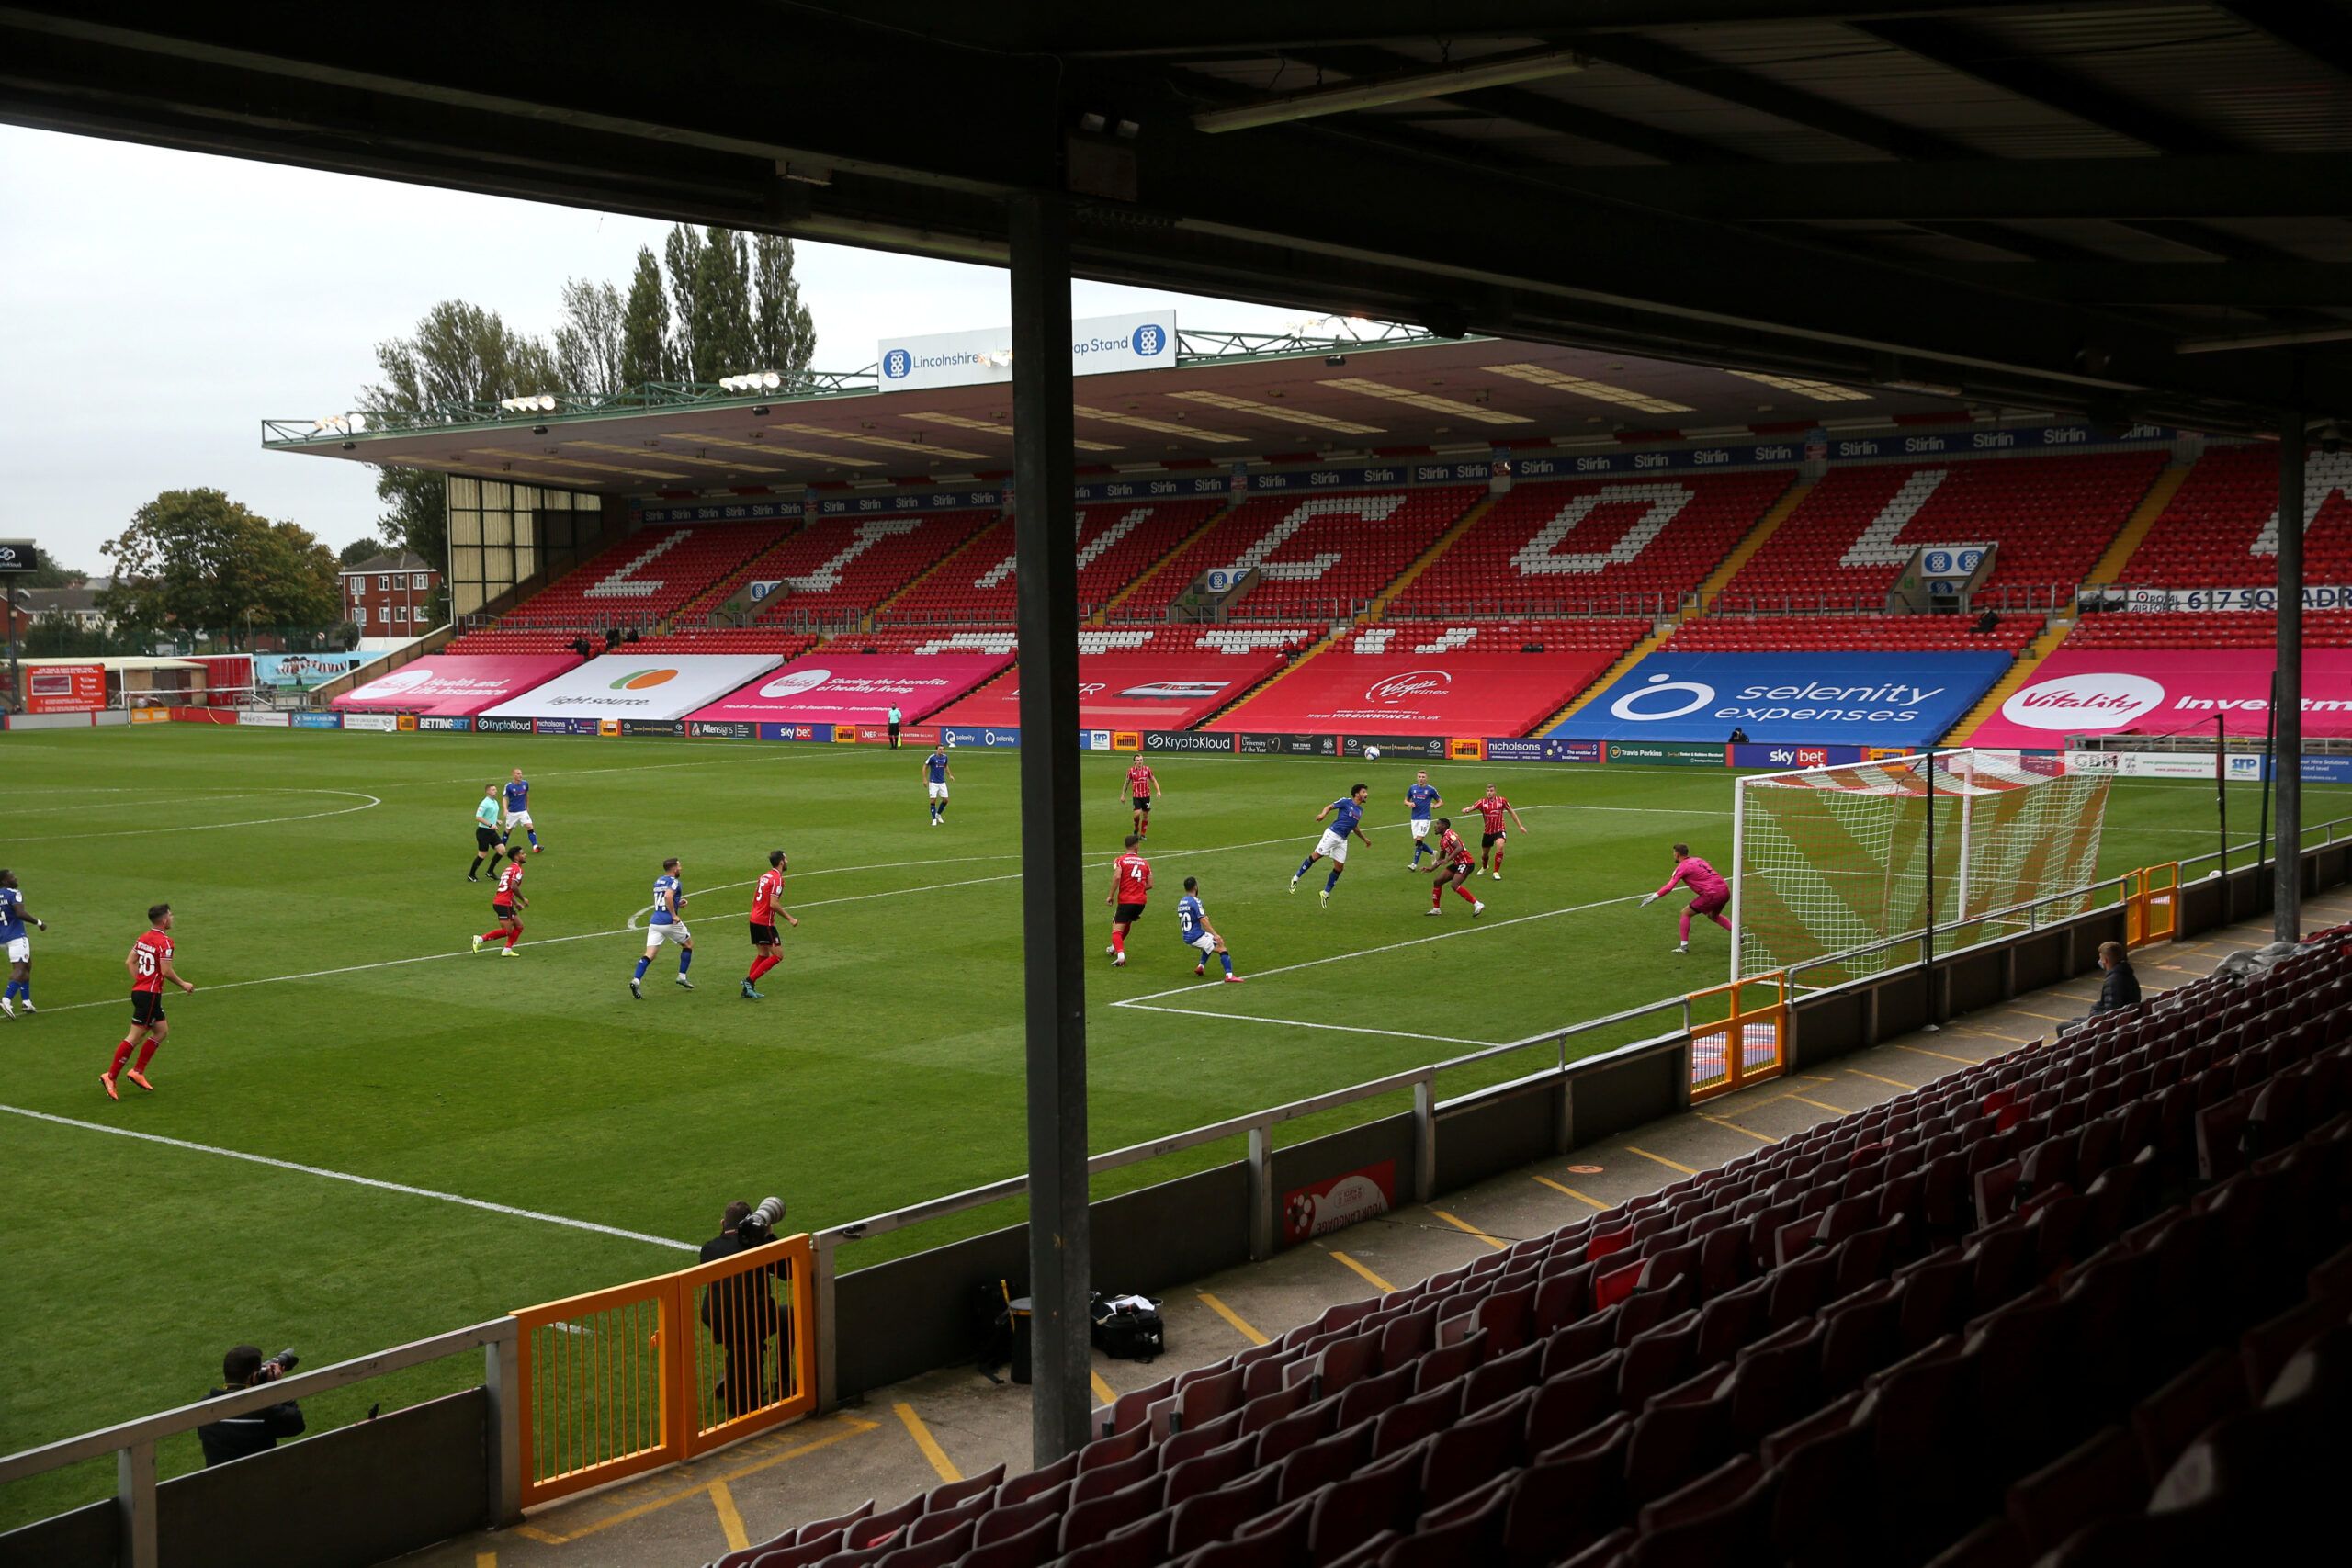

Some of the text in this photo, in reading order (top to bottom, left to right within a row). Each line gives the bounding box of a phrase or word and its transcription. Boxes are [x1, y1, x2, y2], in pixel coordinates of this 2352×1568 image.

[913, 352, 978, 368] Lincolnshire
[1091, 335, 1128, 352] Stand
[1840, 423, 2160, 456] Stirlin Stirlin Stirlin Stirlin tirlin
[1521, 446, 1792, 474] Stirlin Stirlin Stirlin Stirlin Stirlin
[1259, 470, 1393, 488] Stirlin Stirlin Stirlin
[1419, 465, 1487, 479] Stirlin Stirlin
[1075, 479, 1222, 498] irlin Stirlin Stirlin Stirlin
[824, 492, 994, 513] Stirlin Stirlin Stirlin Stirlin Stirlin
[646, 503, 801, 522] Stirlin Stirlin Stirlin Stirlin Stirlin Stirlin
[2132, 604, 2148, 613] AIR
[2150, 603, 2181, 613] FORCE
[2188, 592, 2233, 610] 617
[2148, 594, 2179, 604] ROYAL
[427, 677, 509, 687] Health and
[828, 677, 876, 686] Sharing
[831, 685, 876, 694] healthy
[1379, 676, 1438, 697] Virgin
[440, 687, 507, 696] Insurance
[1736, 682, 1946, 706] selenity
[2021, 690, 2143, 715] Vitality
[1714, 707, 1919, 722] expenses
[489, 719, 531, 731] KryptoKloud
[781, 728, 810, 739] sky bet
[956, 734, 975, 742] selenity
[996, 735, 1015, 744] selenity
[1165, 736, 1230, 750] KryptoKloud
[1488, 741, 1540, 751] nicholsons
[1770, 749, 1824, 762] sky bet
[1131, 865, 1142, 882] 4
[654, 892, 665, 911] 14
[1317, 1211, 1361, 1233] LANGUAGE
